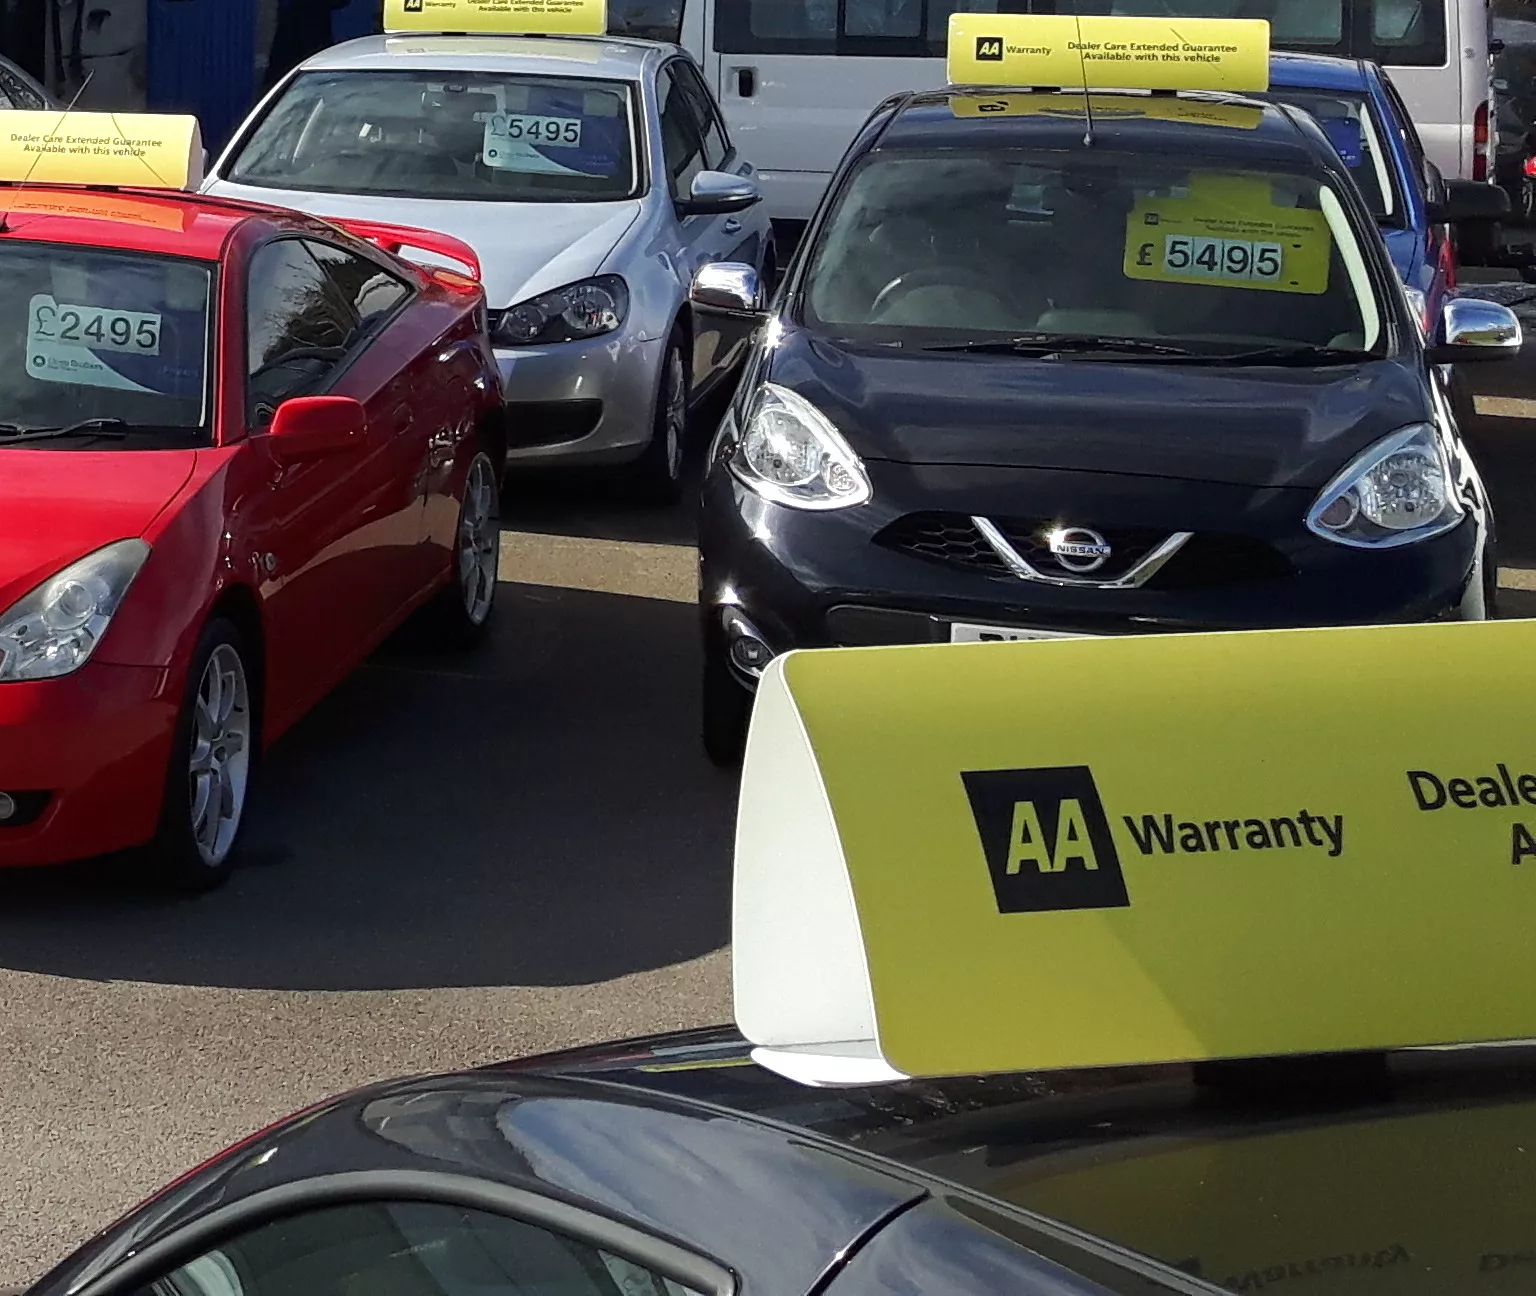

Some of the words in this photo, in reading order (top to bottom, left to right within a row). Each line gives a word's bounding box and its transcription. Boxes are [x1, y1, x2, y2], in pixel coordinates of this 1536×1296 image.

[1006, 45, 1052, 57] Warranty
[1067, 41, 1101, 52] Dealer
[1104, 42, 1128, 52] Care
[1130, 42, 1179, 53] Extended
[1181, 43, 1238, 54] Guarantee
[1083, 52, 1132, 62] Available
[1134, 52, 1158, 62] with
[1160, 52, 1181, 63] this
[1184, 52, 1221, 64] vehicle
[10, 133, 40, 143] Dealer
[69, 145, 89, 155] with
[92, 146, 110, 156] this
[1056, 544, 1104, 554] NISSAN
[1005, 799, 1099, 874] AA
[1123, 808, 1343, 857] Warranty
